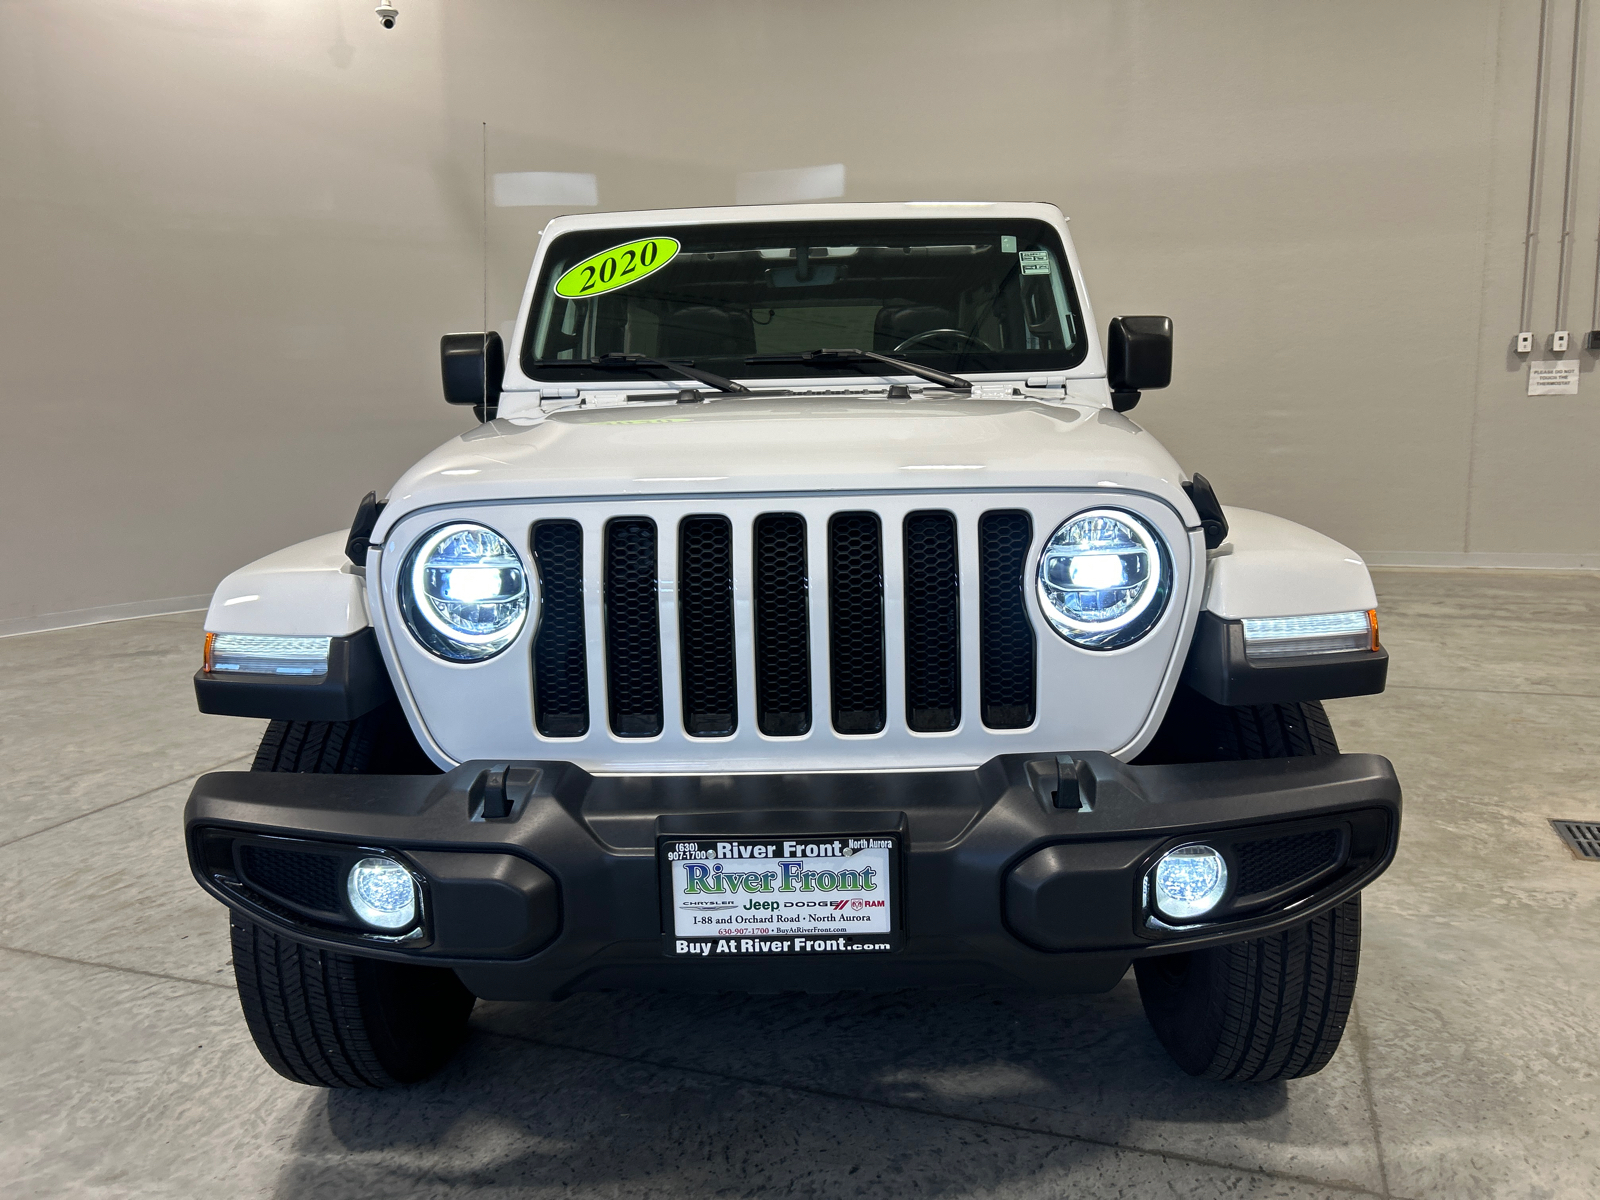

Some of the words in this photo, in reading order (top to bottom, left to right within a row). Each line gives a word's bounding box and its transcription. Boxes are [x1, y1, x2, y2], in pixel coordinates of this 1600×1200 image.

[579, 242, 657, 293] 2020
[676, 843, 698, 851] (630)
[717, 842, 776, 858] River
[784, 841, 842, 857] Front
[849, 839, 868, 848] North
[869, 840, 892, 849] Aurora
[668, 851, 706, 860] 907-1700
[683, 863, 778, 894] River
[778, 861, 877, 892] Front
[743, 899, 780, 912] Jeep
[693, 916, 712, 924] I-88
[715, 916, 732, 924] and
[735, 915, 773, 924] Orchard
[808, 914, 836, 922] North
[776, 926, 847, 934] BuyAtRiverFront.com
[676, 940, 711, 955] Buy
[717, 940, 737, 952] At
[741, 939, 791, 952] River
[795, 937, 890, 950] Front.com
